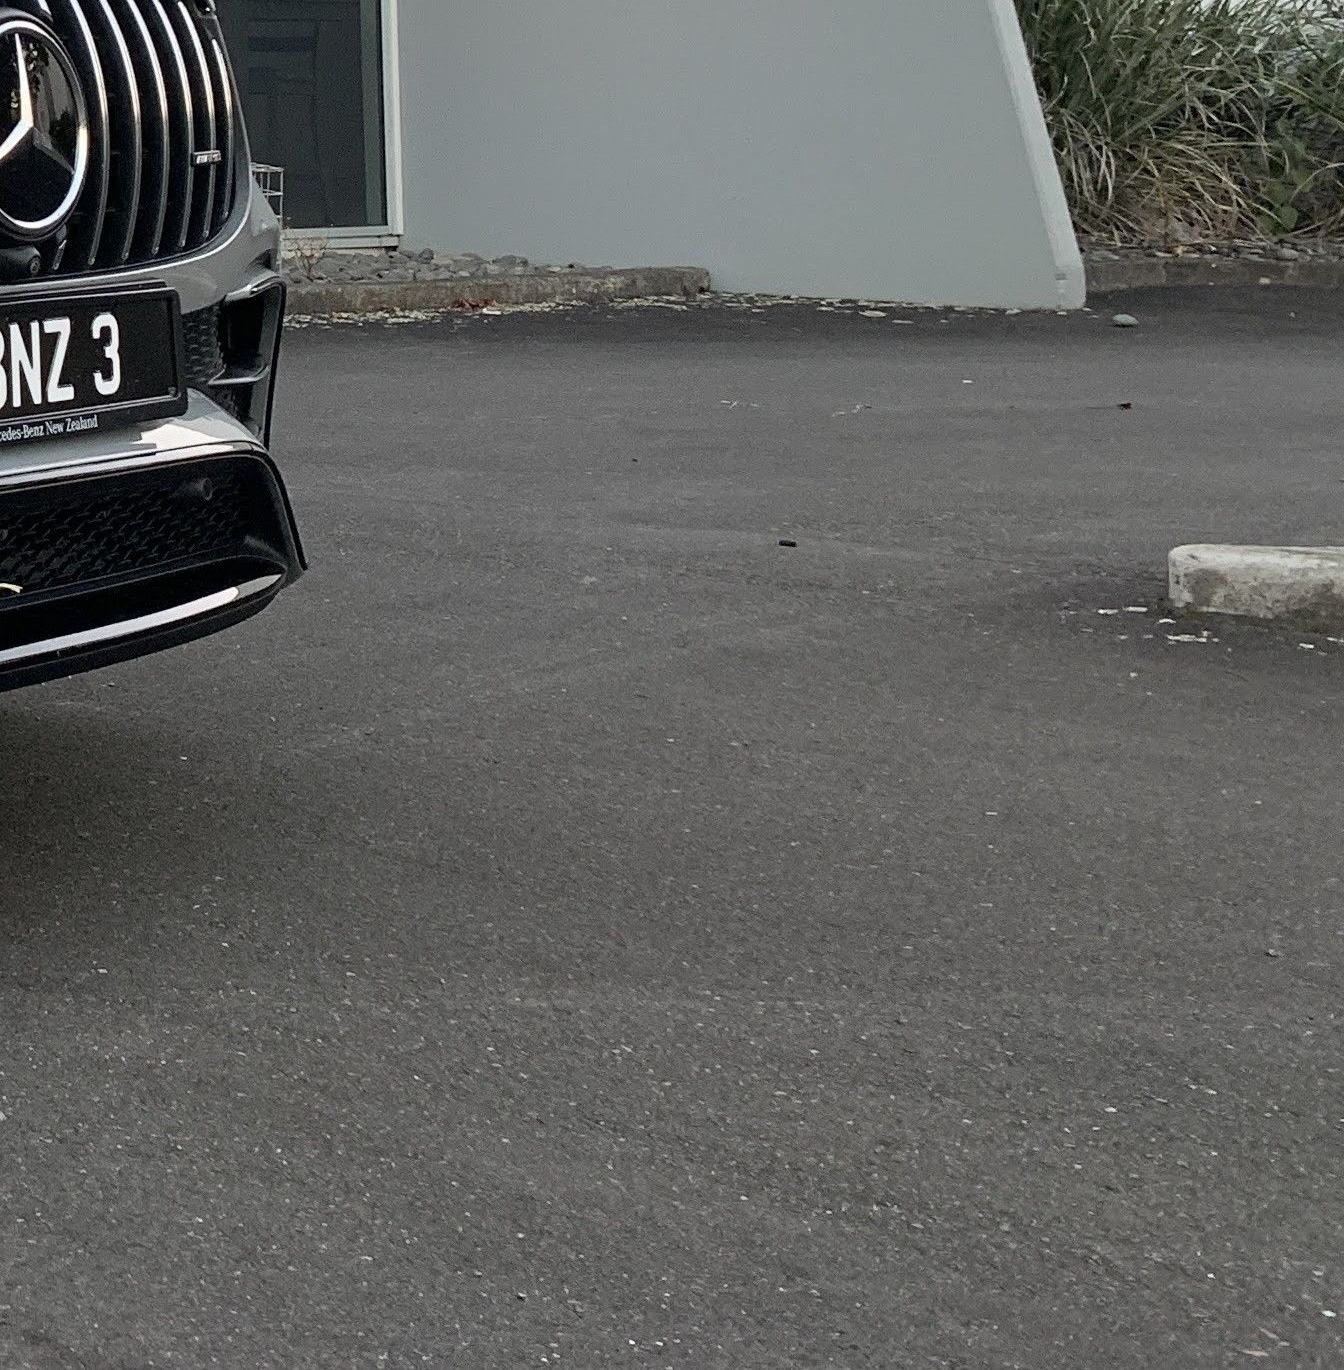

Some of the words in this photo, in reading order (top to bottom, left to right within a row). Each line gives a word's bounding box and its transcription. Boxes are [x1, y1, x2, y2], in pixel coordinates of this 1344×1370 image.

[91, 311, 122, 396] 3
[45, 420, 65, 436] New
[65, 414, 98, 432] Zealand
